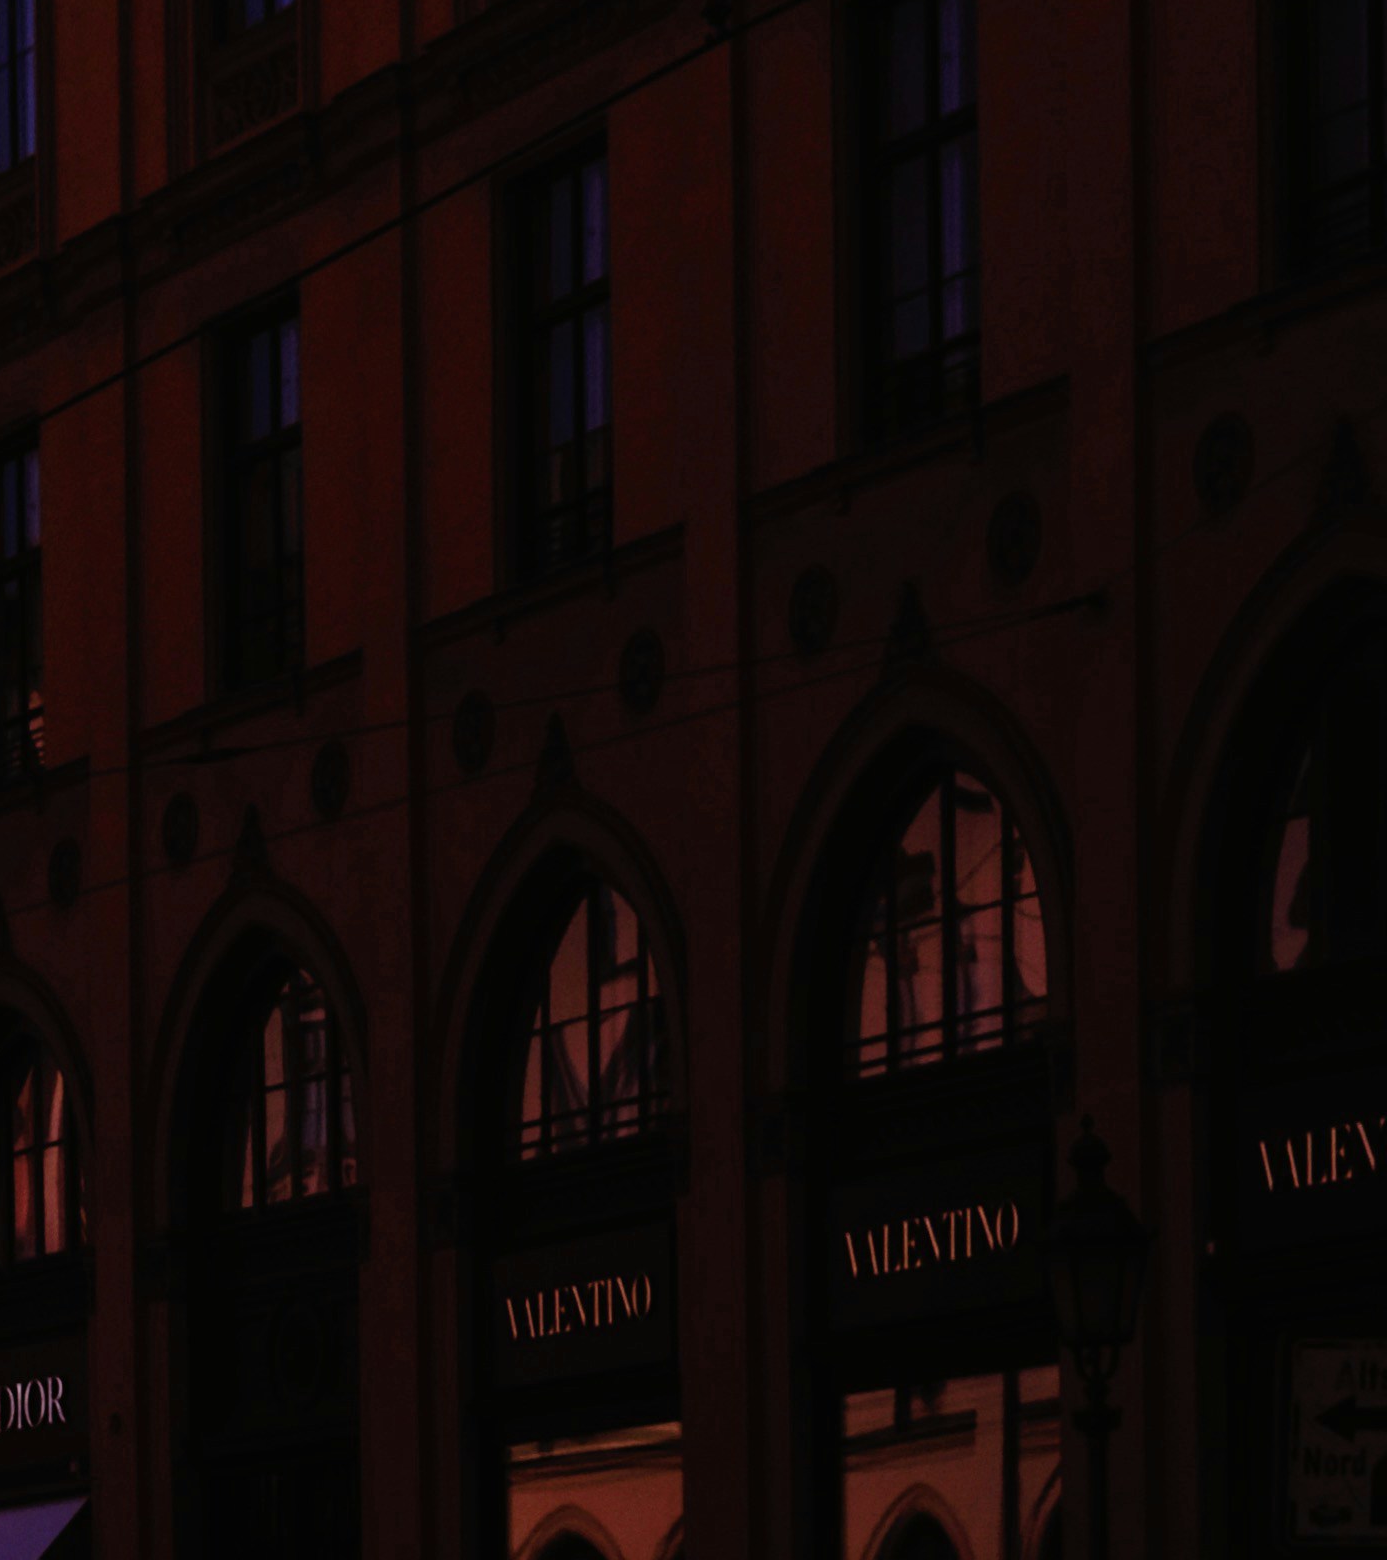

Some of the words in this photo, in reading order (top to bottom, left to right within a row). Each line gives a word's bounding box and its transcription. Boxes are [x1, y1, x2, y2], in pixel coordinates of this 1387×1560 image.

[1258, 1115, 1387, 1193] VALEN
[843, 1199, 1020, 1280] VALENTINO
[505, 1271, 652, 1343] VALENTINO
[1303, 1447, 1367, 1477] Nord
